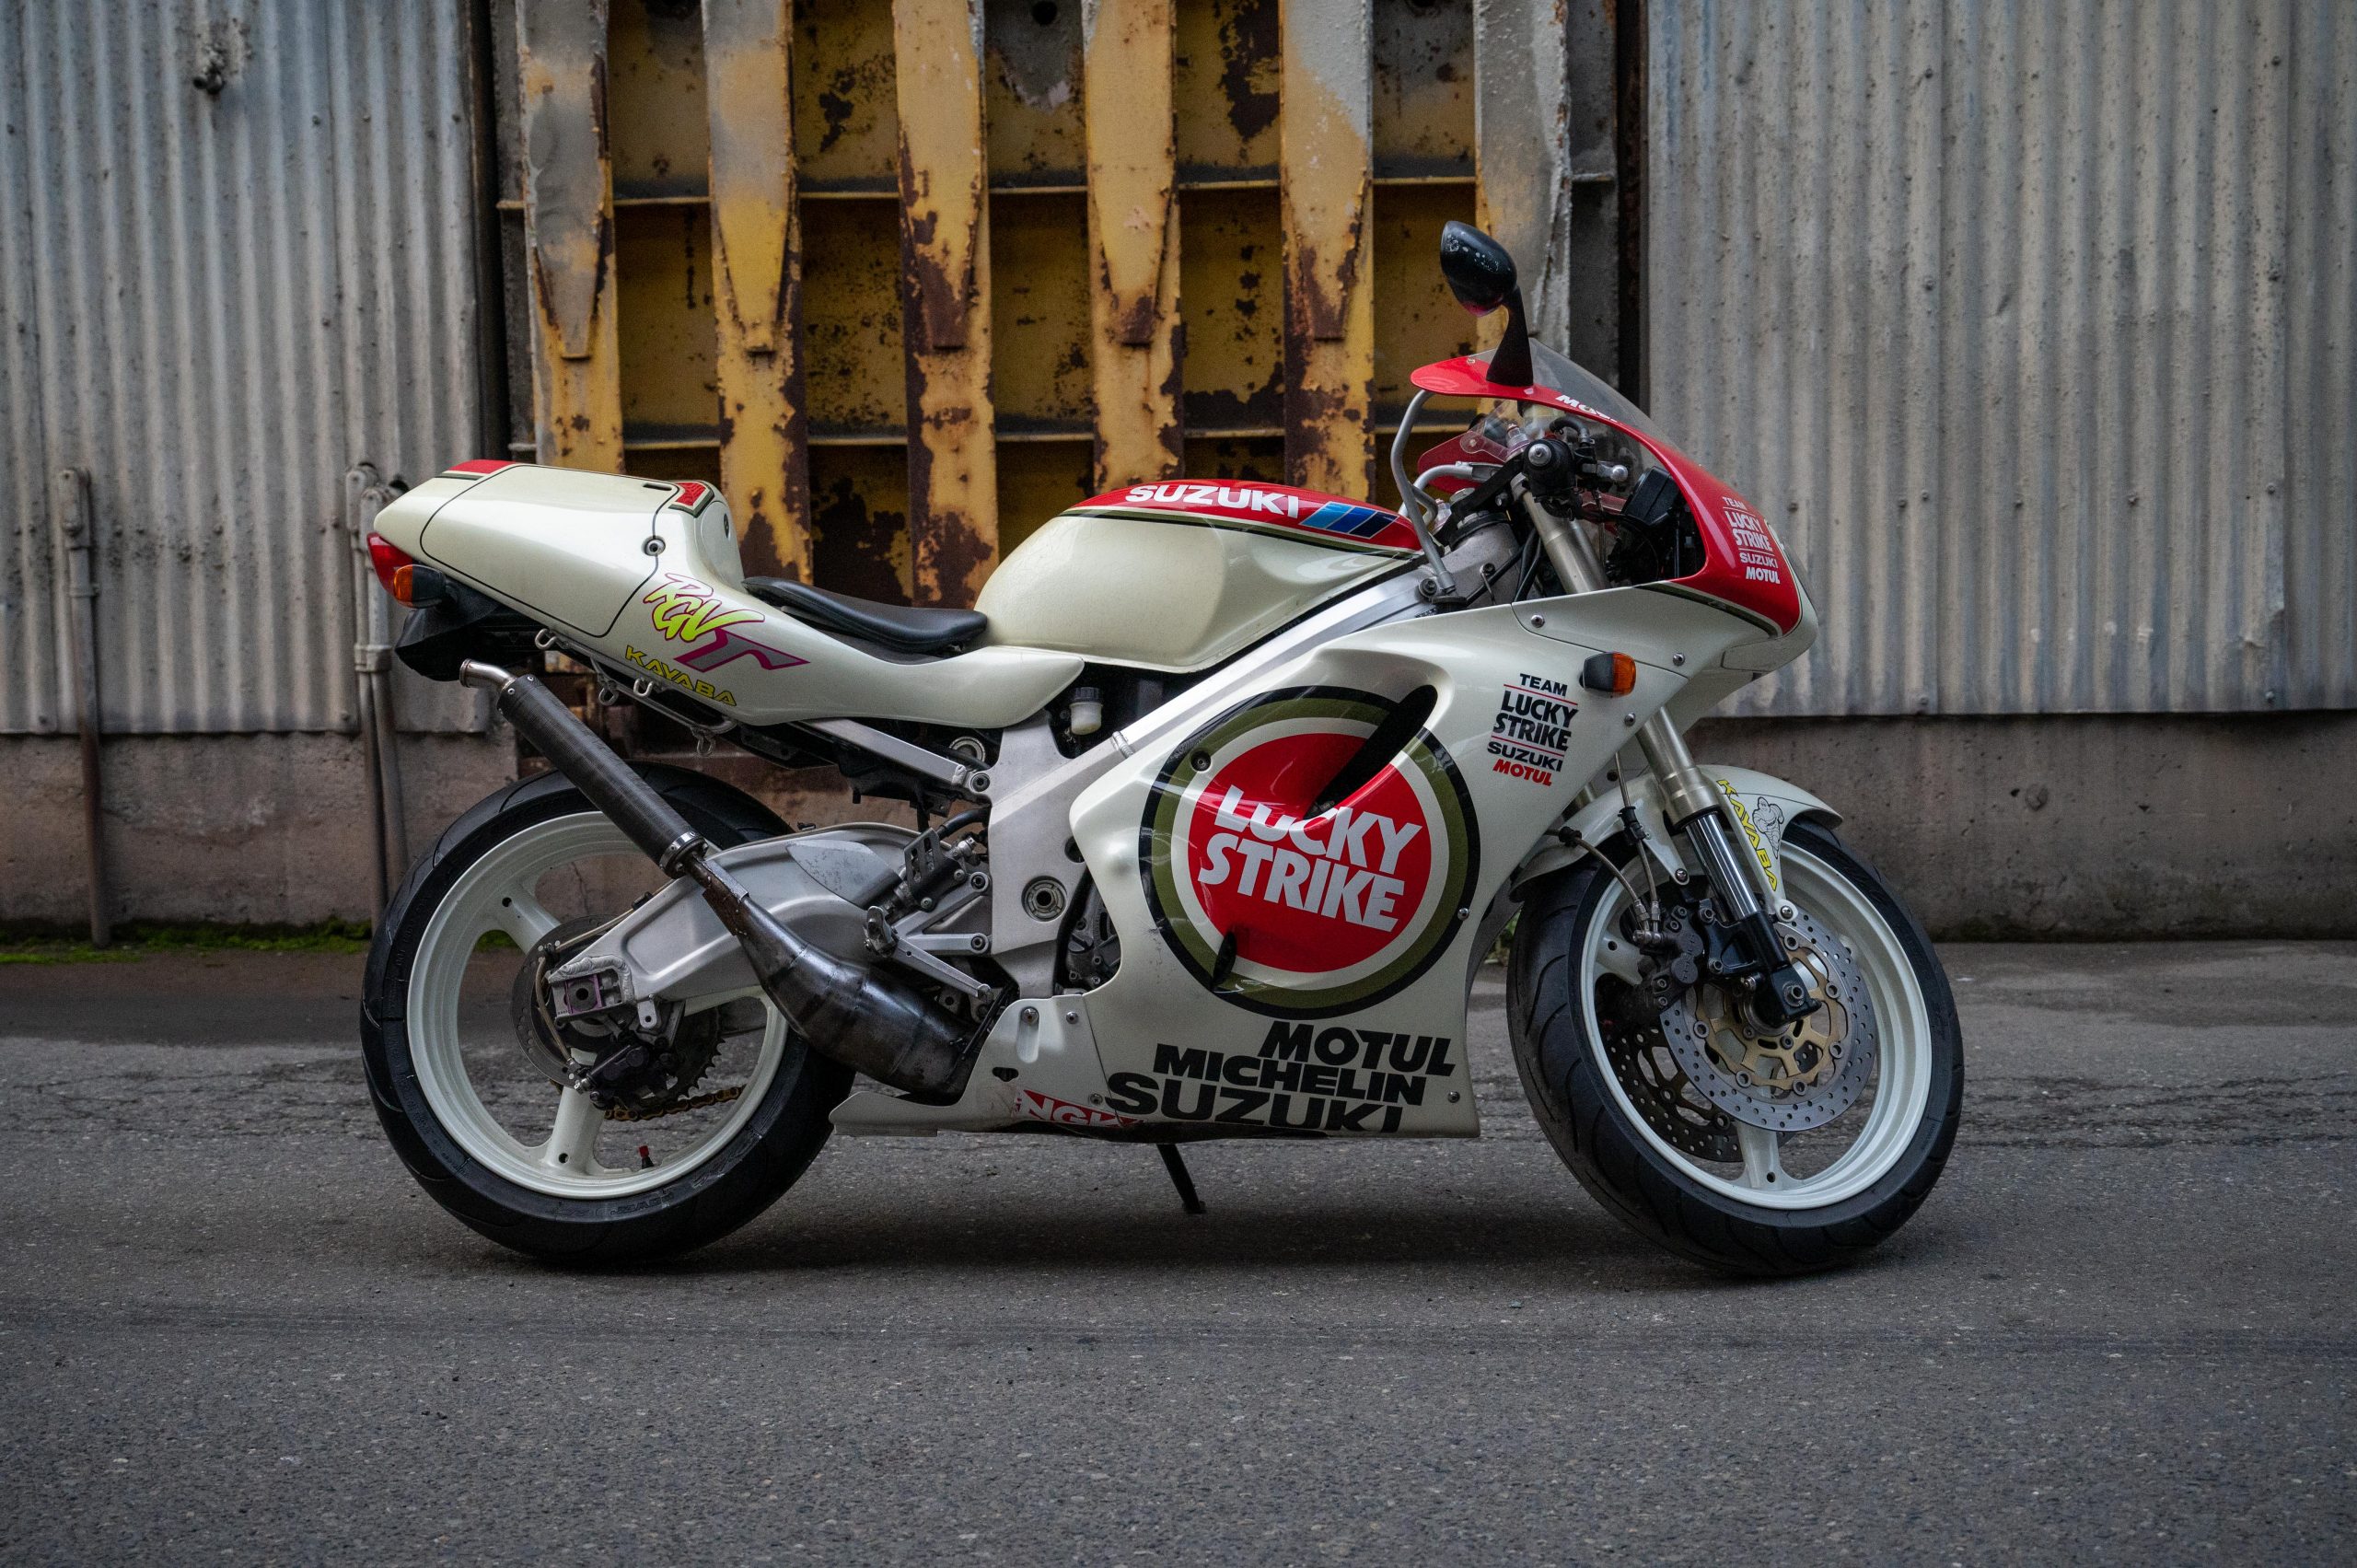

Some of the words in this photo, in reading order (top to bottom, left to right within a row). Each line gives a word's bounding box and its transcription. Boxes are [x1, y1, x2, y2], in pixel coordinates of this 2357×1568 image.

[1125, 484, 1299, 519] SUZUKI
[1722, 496, 1747, 511] TEAM
[1724, 510, 1765, 534] LUCKY
[1732, 528, 1773, 552] STRIKE
[1739, 552, 1779, 569] SUZUKI
[1746, 566, 1781, 585] MOTUL
[643, 573, 765, 643] RGV
[625, 645, 737, 707] KAYABA
[1519, 673, 1568, 697] TEAM
[1501, 690, 1579, 728] LUCKY
[1492, 712, 1572, 752] STRIKE
[1487, 741, 1563, 772] SUZUKI
[1492, 758, 1552, 787] MOTUL
[1214, 784, 1422, 875] LUCKY
[1716, 778, 1778, 892] KAYABA
[1197, 832, 1405, 933] STRIKE
[1258, 1020, 1457, 1077] MOTUL
[1153, 1043, 1427, 1106] MICHELIN
[1105, 1072, 1403, 1133] SUZUKI
